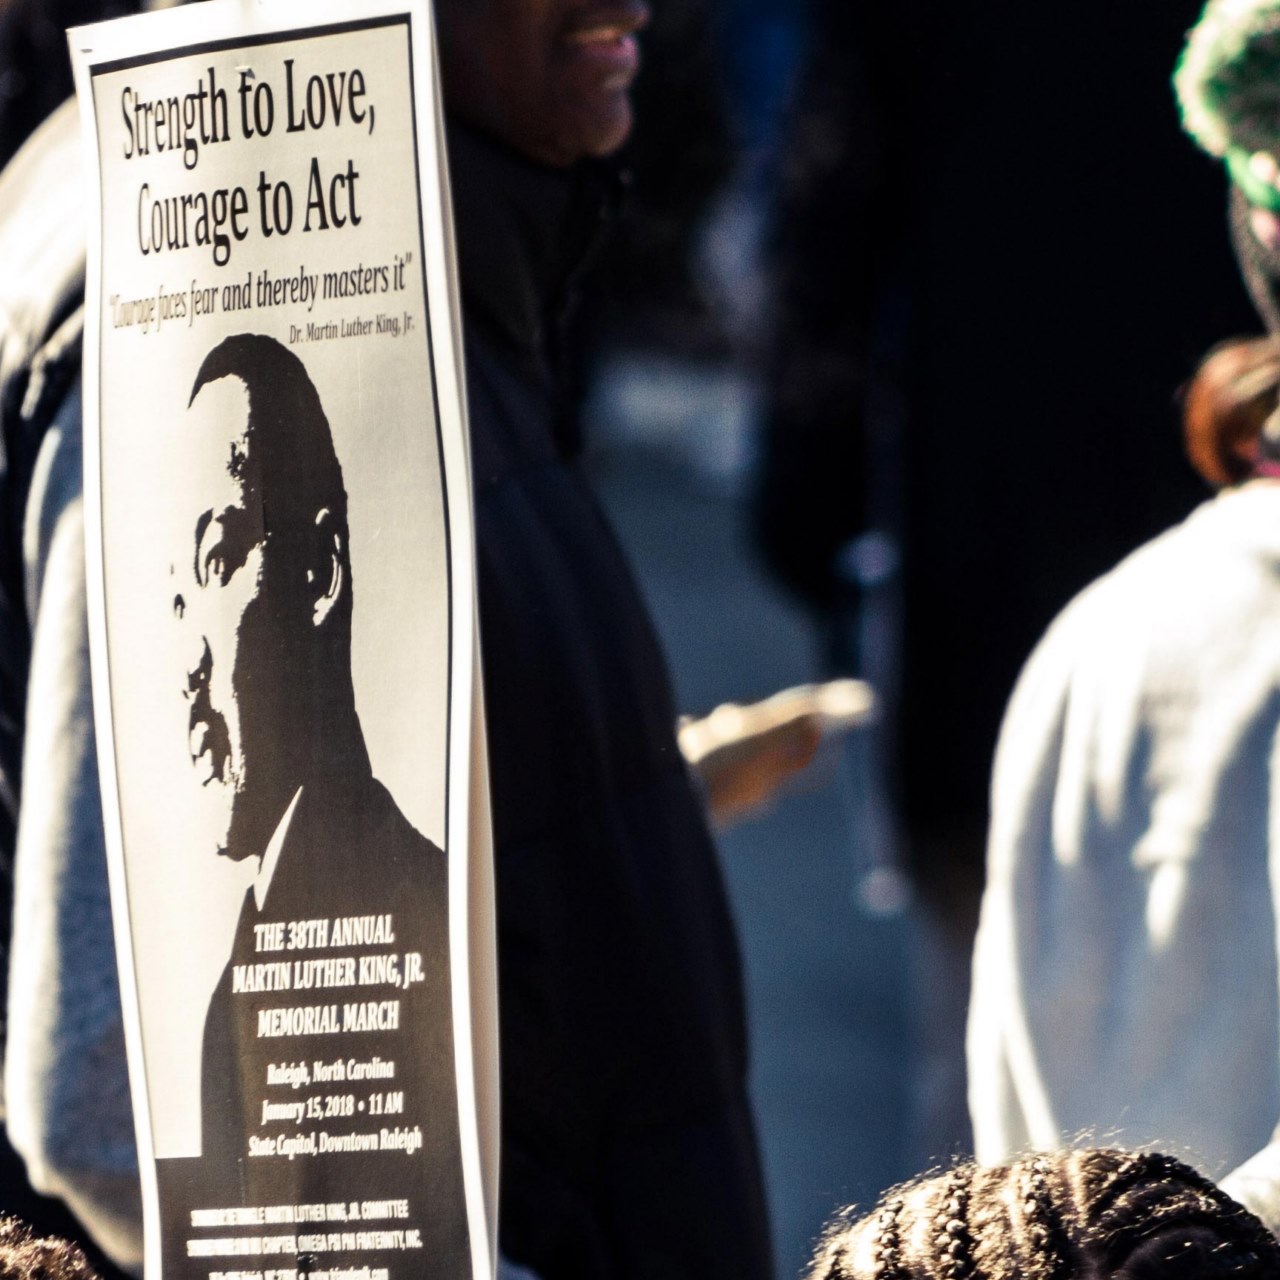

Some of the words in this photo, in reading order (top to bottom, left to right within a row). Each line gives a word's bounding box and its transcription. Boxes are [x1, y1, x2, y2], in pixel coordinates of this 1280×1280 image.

[122, 67, 230, 169] Strength
[238, 71, 274, 140] to
[284, 60, 376, 136] Love,
[138, 183, 249, 266] Courage
[257, 170, 294, 239] to
[303, 157, 361, 232] Act
[157, 285, 188, 332] faces
[189, 279, 218, 327] fear
[222, 272, 252, 312] and
[256, 266, 319, 311] thereby
[323, 263, 389, 299] masters
[290, 324, 303, 344] Dr.
[306, 319, 338, 342] Martin
[341, 316, 372, 339] Luther
[376, 313, 401, 338] King,
[402, 311, 415, 333] Jr.
[254, 923, 286, 952] THE
[287, 919, 329, 951] 38TH
[330, 915, 395, 948] ANNUAL
[232, 962, 291, 993] MARTIN
[293, 958, 356, 990] LUTHER
[358, 954, 402, 987] KING,
[402, 953, 425, 989] JR.
[257, 1004, 340, 1038] MEMORIAL
[342, 1000, 400, 1033] MARCH
[267, 1060, 311, 1089] Raleigh,
[313, 1060, 345, 1083] North
[347, 1057, 395, 1081] Carolina
[261, 1097, 305, 1125] January
[306, 1096, 324, 1120] 15,
[324, 1095, 354, 1118] 2018
[368, 1093, 383, 1115] 11
[383, 1092, 404, 1114] AM
[248, 1135, 276, 1157] State
[276, 1132, 318, 1160] Capitol,
[319, 1130, 379, 1155] Downtown
[380, 1125, 422, 1155] Raleigh
